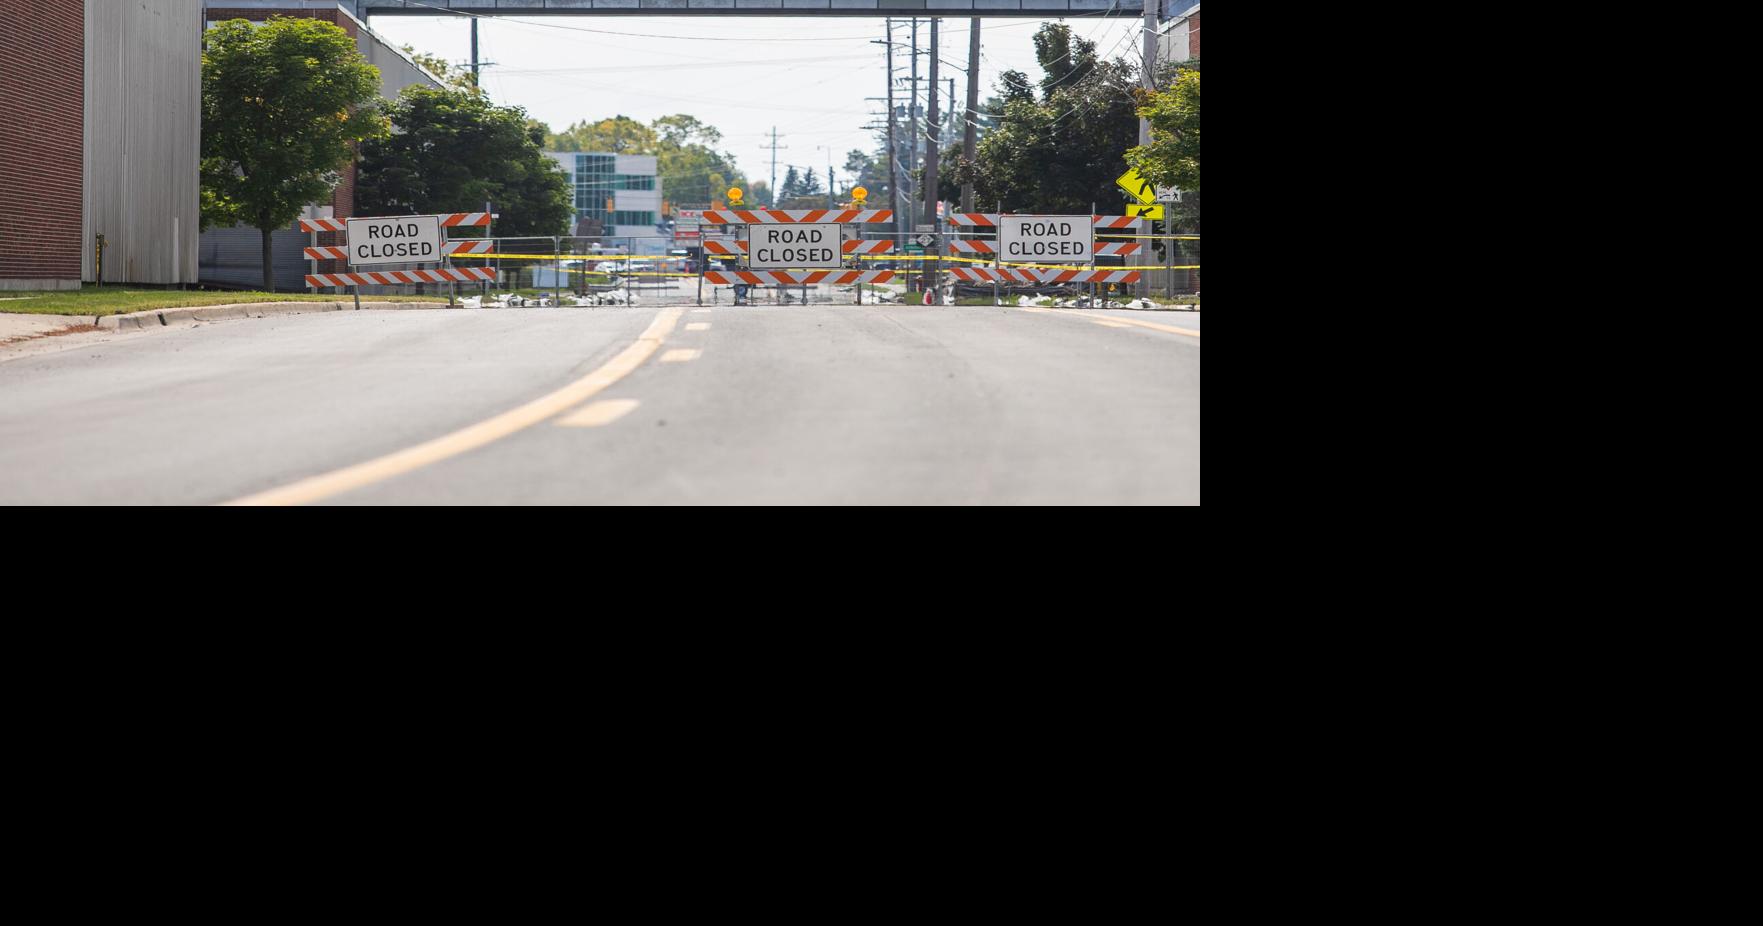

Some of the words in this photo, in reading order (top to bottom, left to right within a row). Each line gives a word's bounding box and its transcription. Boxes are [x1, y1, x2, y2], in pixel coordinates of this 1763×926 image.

[368, 223, 419, 239] ROAD
[767, 229, 823, 244] ROAD
[1020, 222, 1072, 237] ROAD
[357, 241, 433, 259] CLOSED
[757, 248, 834, 263] CLOSED
[1008, 241, 1084, 256] CLOSED
